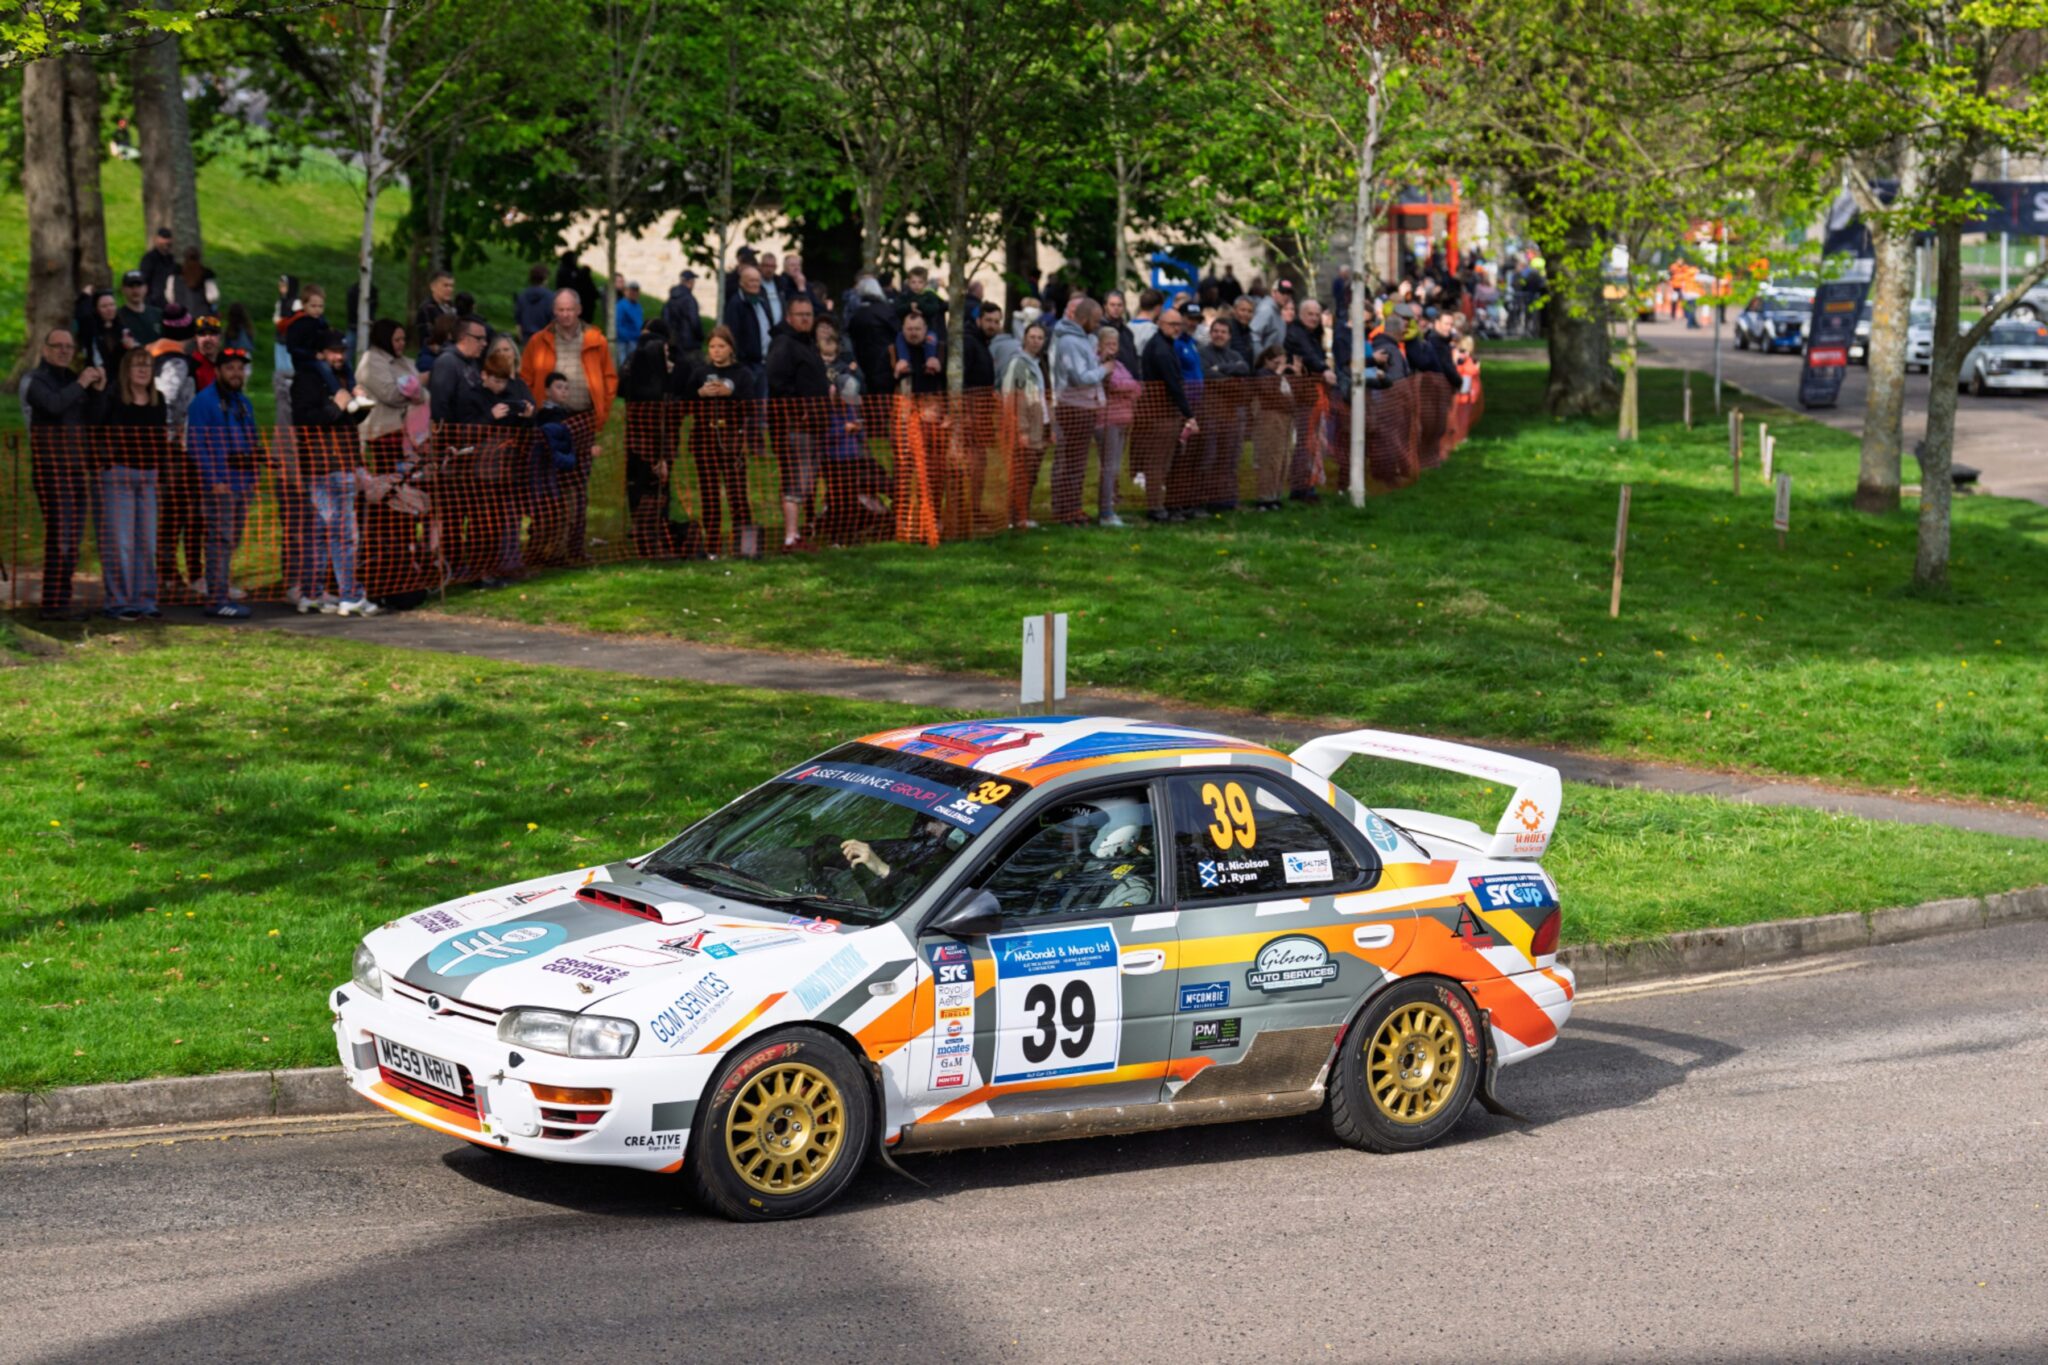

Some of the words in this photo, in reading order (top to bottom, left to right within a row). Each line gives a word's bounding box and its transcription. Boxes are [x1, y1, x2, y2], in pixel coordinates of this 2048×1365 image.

[1025, 622, 1035, 644] A
[840, 770, 894, 789] ALLIANCE
[891, 783, 937, 800] GROUP
[967, 781, 1012, 805] 39
[933, 805, 976, 825] CHALLENGER
[1201, 782, 1257, 850] 39
[1014, 947, 1056, 962] McDonald
[1058, 946, 1066, 957] &
[1068, 945, 1095, 956] Munro
[1096, 941, 1111, 952] Ltd
[1261, 949, 1322, 969] Gibsons
[542, 963, 597, 979] COLITIS
[592, 974, 619, 984] UK
[555, 957, 621, 975] CROHN'S
[1252, 973, 1279, 983] AUTO
[1283, 967, 1334, 980] SERVICES
[650, 1006, 685, 1043] GCM
[675, 972, 729, 1020] SERVICES
[1022, 979, 1096, 1063] 39
[1195, 1023, 1216, 1036] PM
[937, 1044, 970, 1055] moates
[380, 1039, 422, 1076] M559
[422, 1055, 455, 1089] NRH
[744, 1049, 777, 1075] MRF
[624, 1134, 681, 1147] CREATIVE
